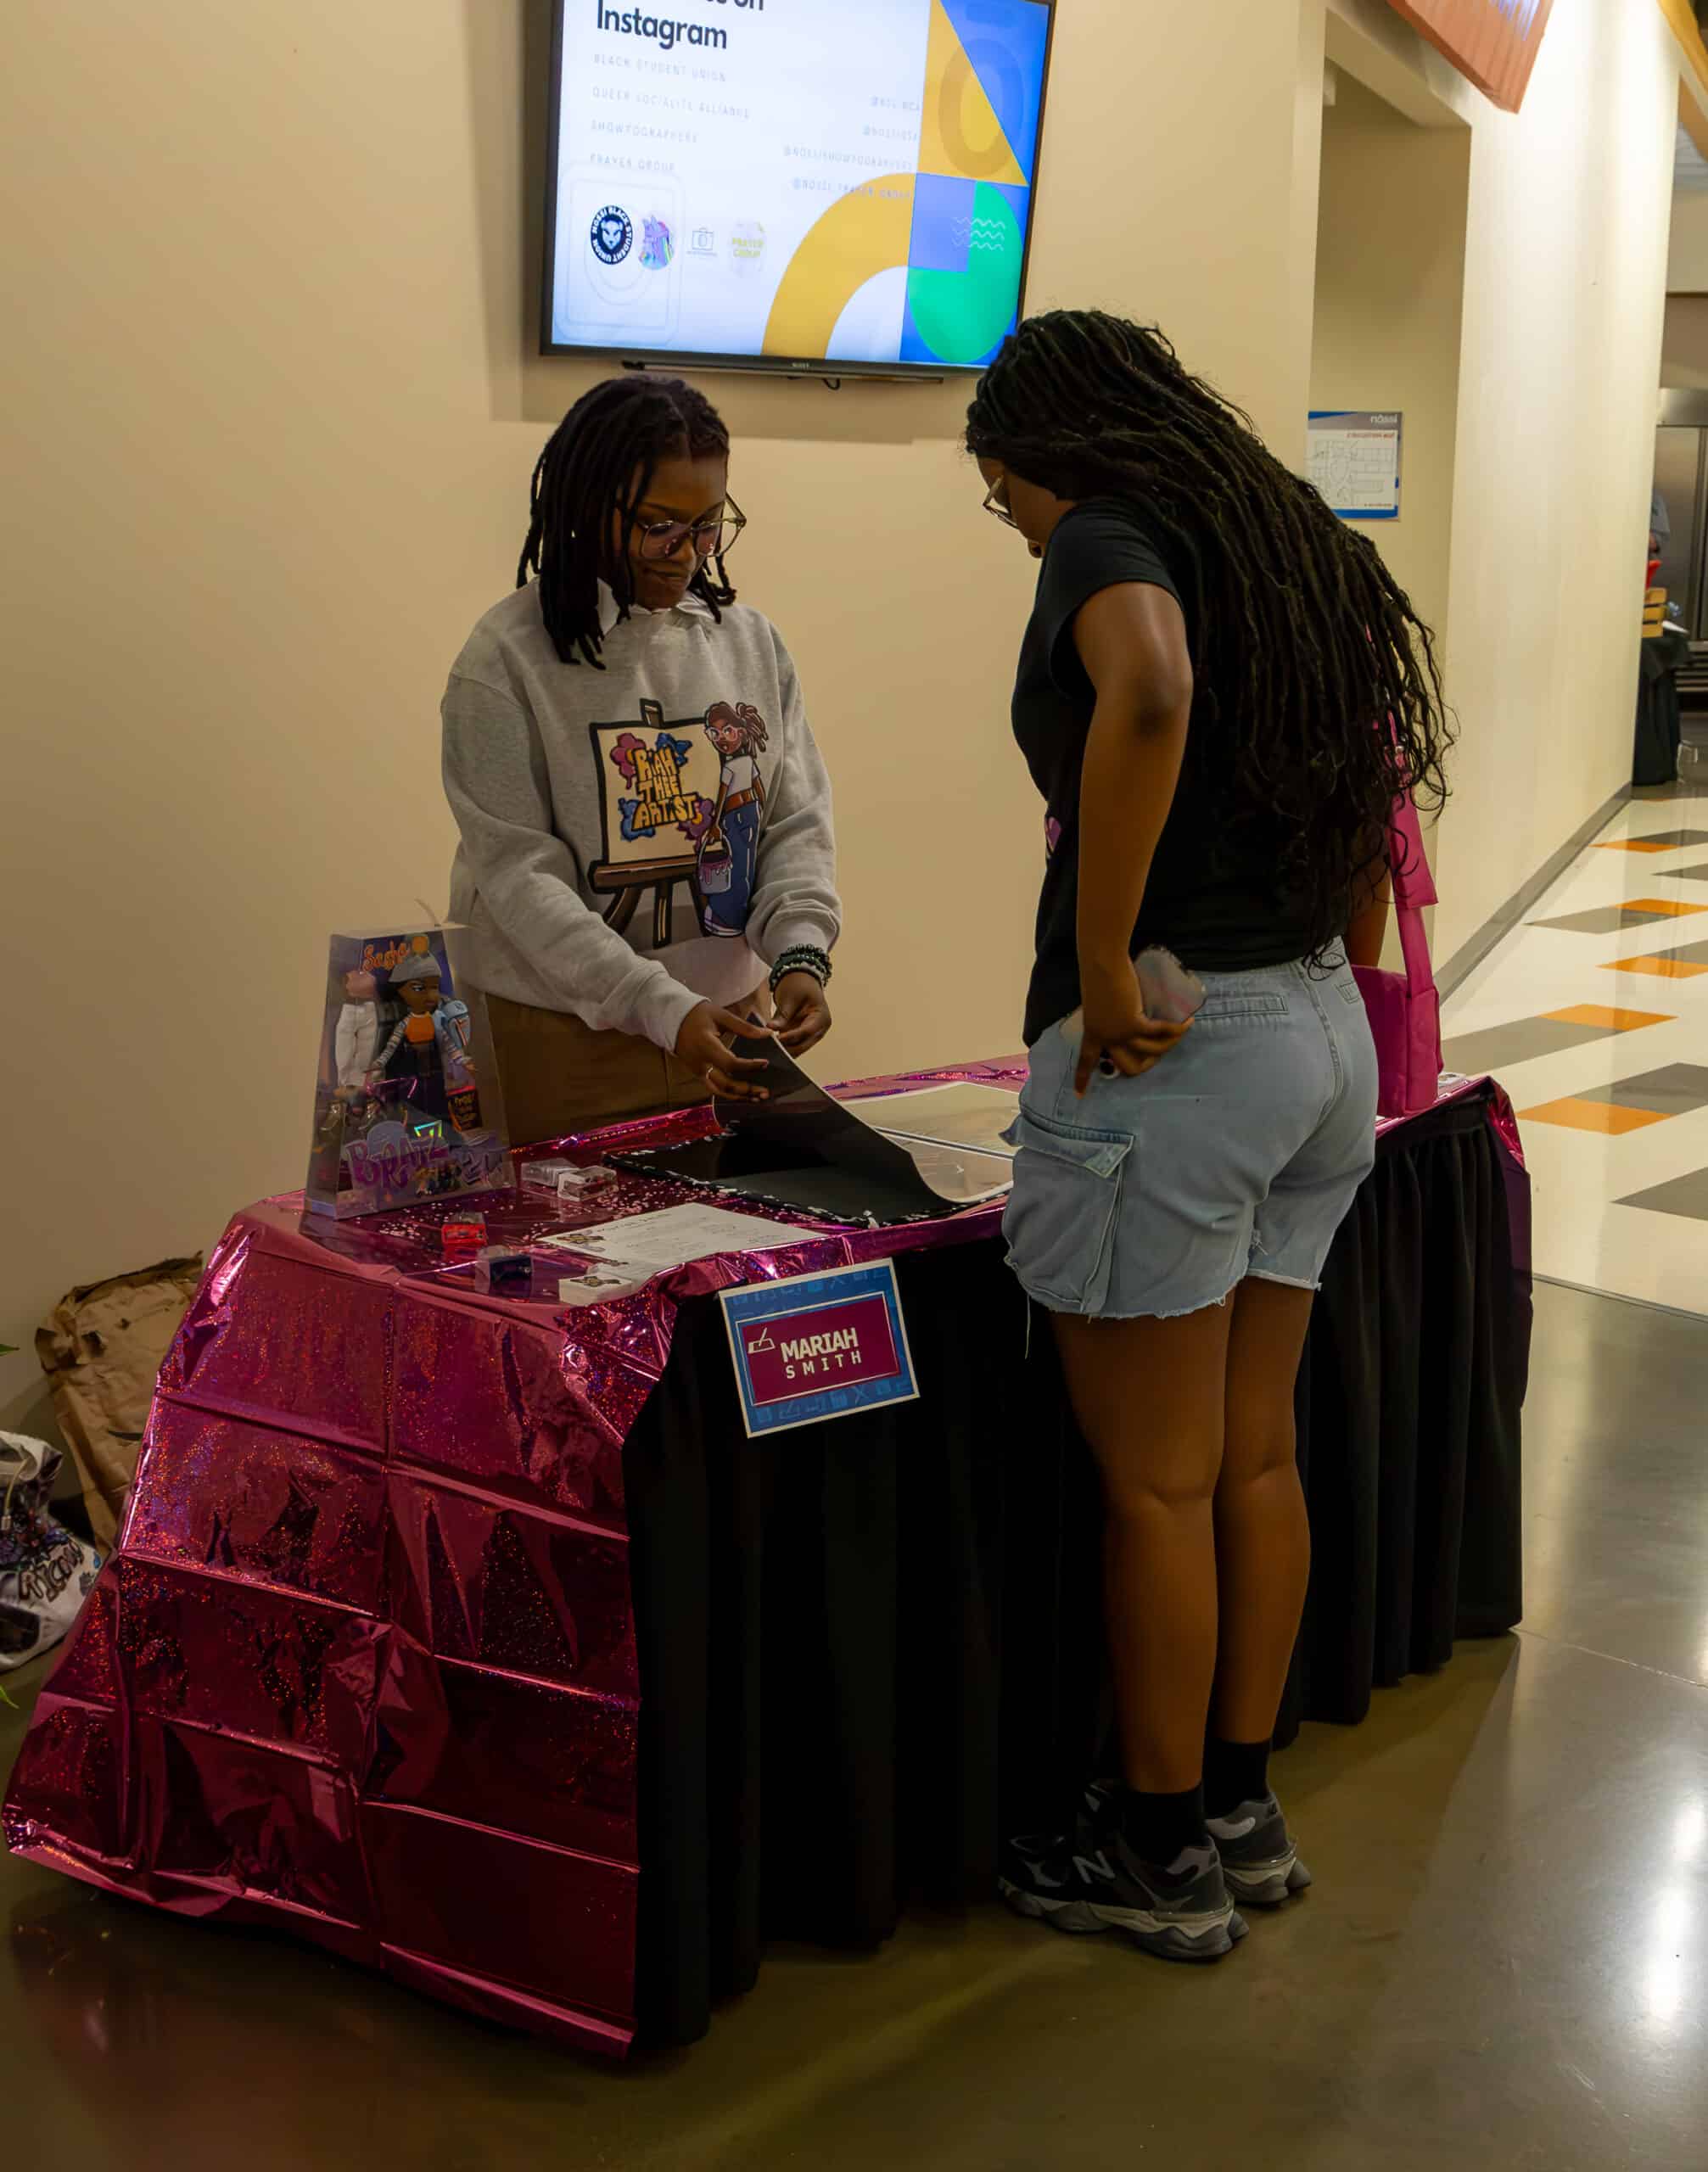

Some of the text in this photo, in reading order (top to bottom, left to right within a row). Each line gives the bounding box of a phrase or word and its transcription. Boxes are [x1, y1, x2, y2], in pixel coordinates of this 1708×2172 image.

[597, 0, 727, 50] Instagram
[780, 1327, 860, 1363] MARIAH
[785, 1351, 862, 1380] SMITH
